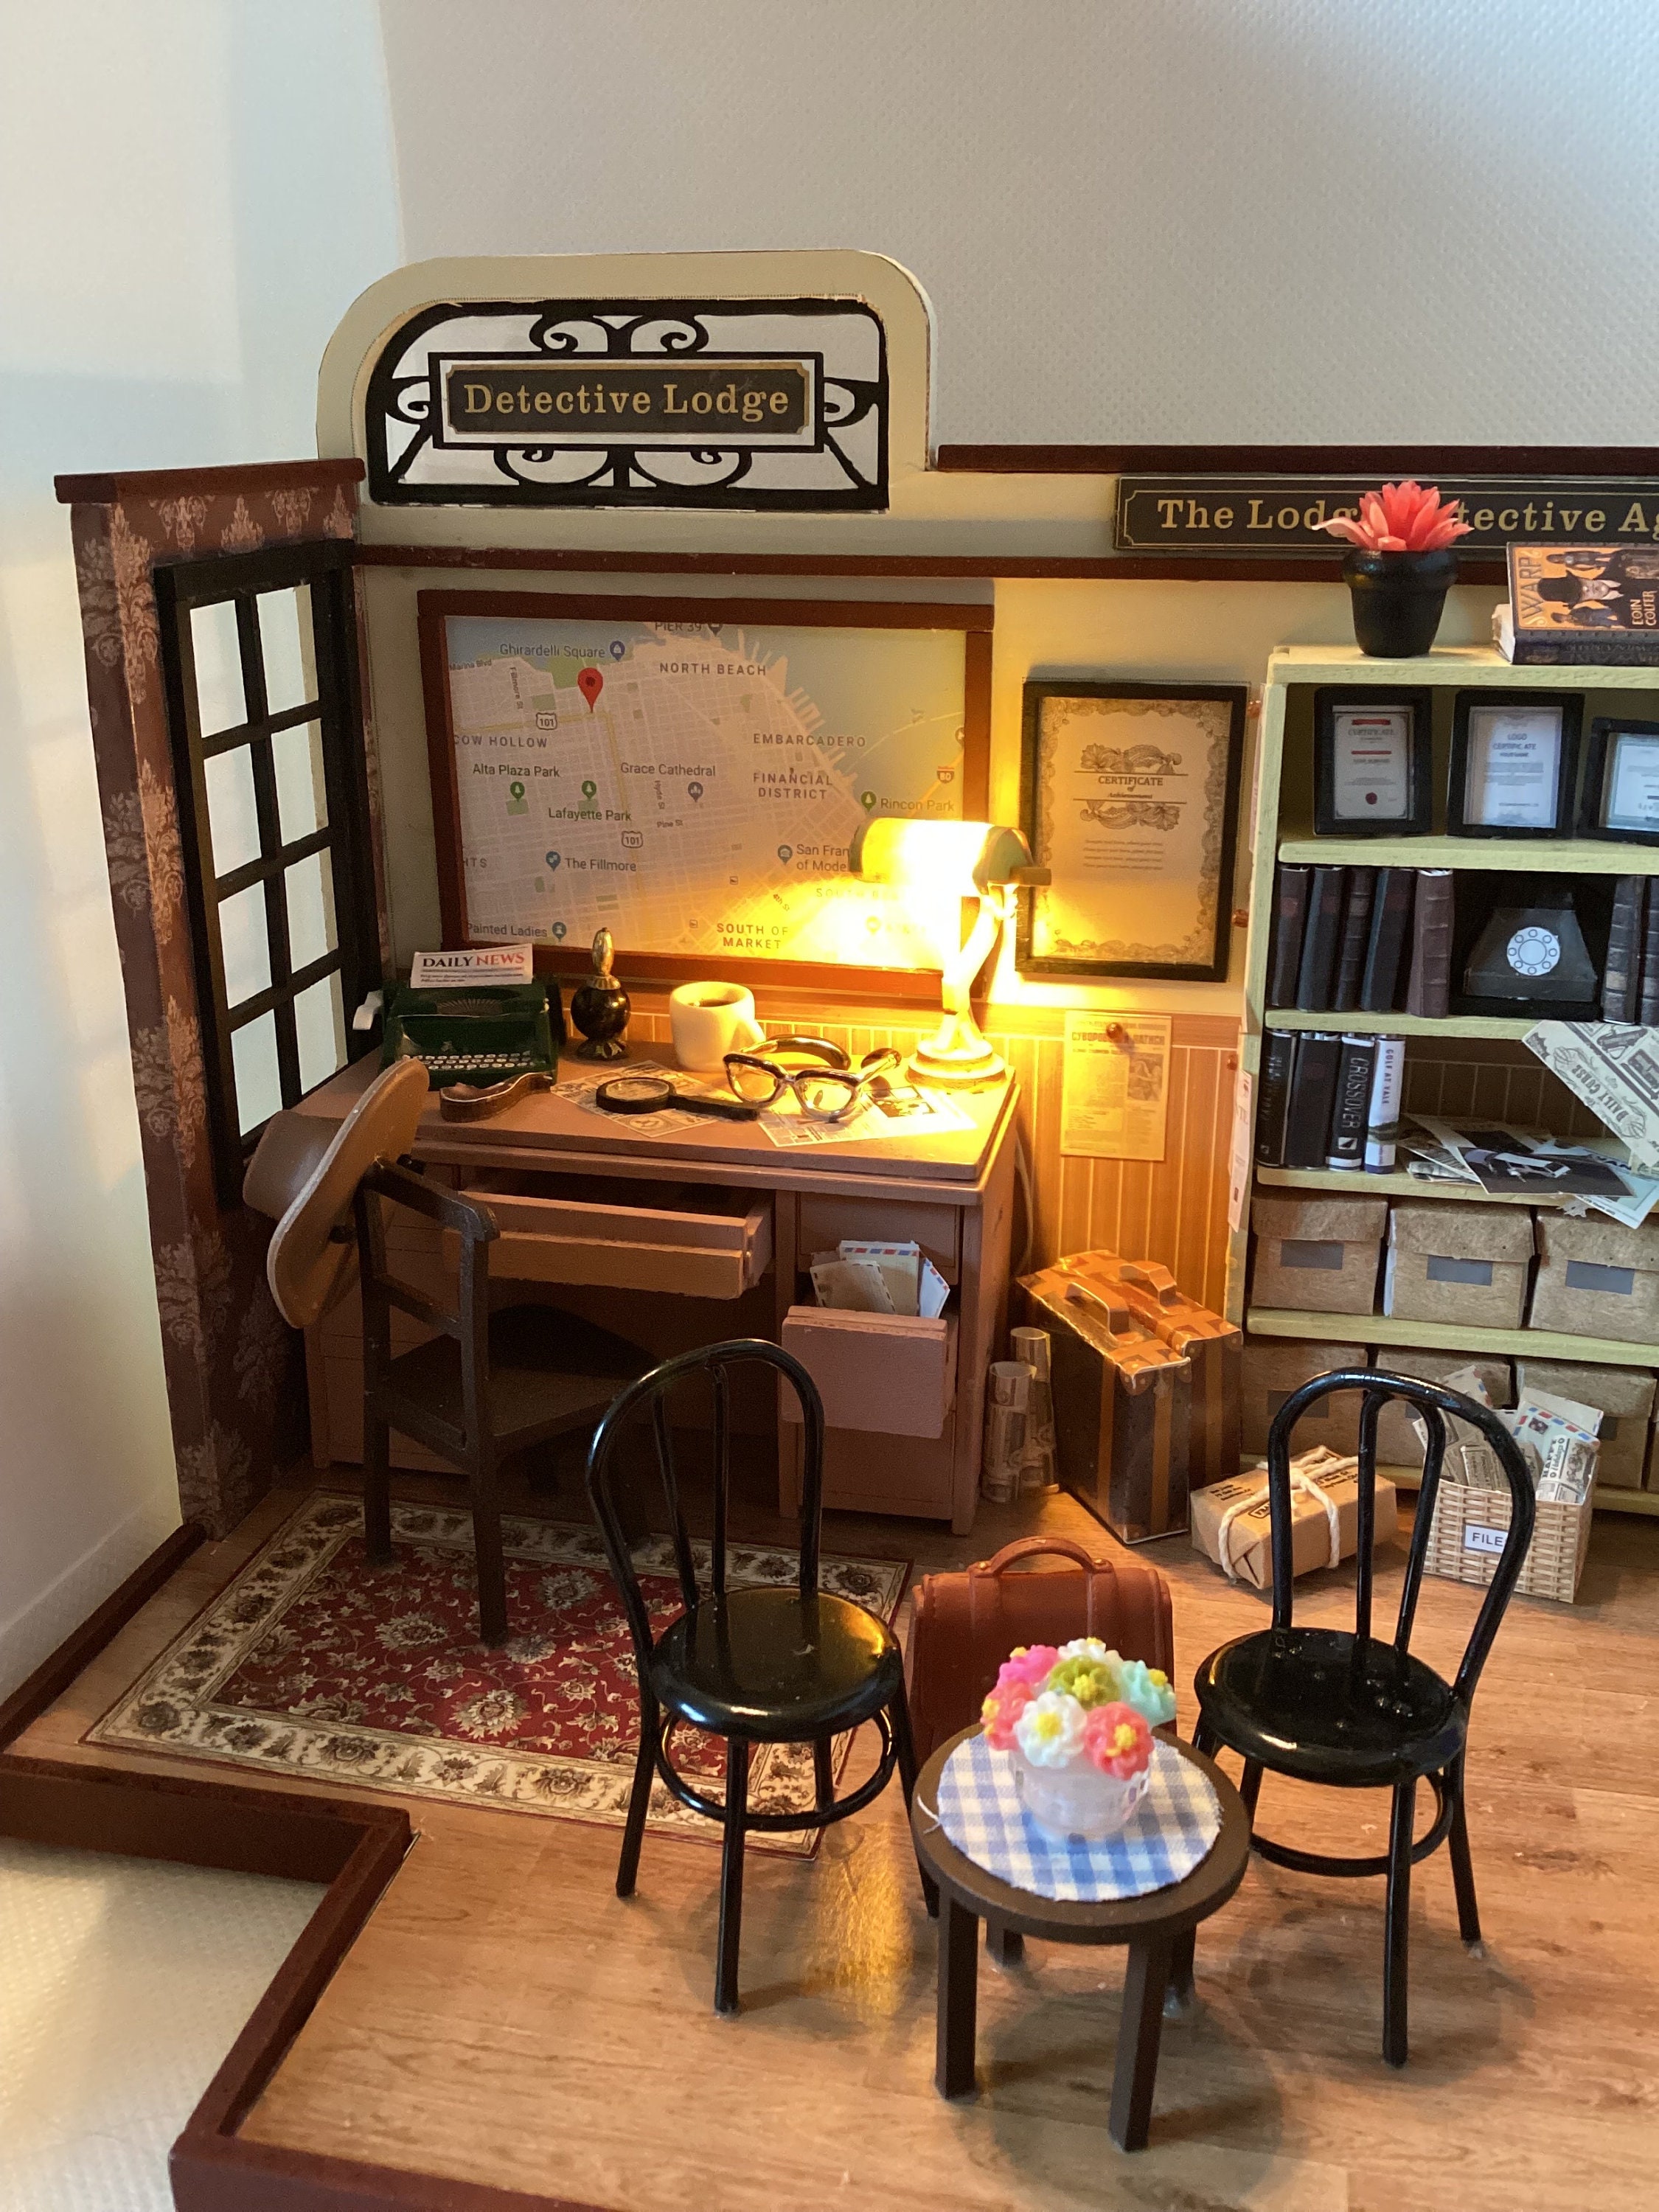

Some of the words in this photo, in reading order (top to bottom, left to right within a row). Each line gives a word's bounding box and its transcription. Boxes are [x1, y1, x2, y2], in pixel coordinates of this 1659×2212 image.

[464, 383, 652, 414] Detective
[663, 383, 790, 422] Lodge
[1157, 498, 1234, 529] The
[1247, 498, 1358, 530] Lod
[1453, 500, 1607, 533] tective
[1518, 556, 1546, 619] WARP
[1629, 599, 1644, 626] EOIN
[655, 622, 683, 632] PIER
[686, 623, 702, 633] 39
[499, 643, 560, 657] Ghirardelli
[563, 645, 606, 660] Square
[659, 663, 710, 674] NORTH
[717, 664, 766, 676] BEACH
[539, 718, 555, 728] 101
[489, 736, 548, 748] HOLLOW
[753, 733, 866, 748] EMBARCADERO
[473, 763, 495, 775] Alta
[498, 765, 531, 776] Plaza
[534, 765, 560, 778] Park
[620, 762, 655, 774] Grace
[658, 763, 716, 776] Cathedral
[753, 772, 833, 787] FINANCIAL
[1098, 776, 1164, 787] CERTIFICATE
[758, 787, 827, 800] DISTRICT
[880, 798, 922, 810] Rincon
[926, 799, 954, 812] Park
[548, 807, 602, 822] Lafayette
[605, 810, 632, 821] Park
[625, 836, 640, 845] 101
[796, 844, 819, 856] San
[564, 858, 587, 870] The
[590, 858, 636, 872] Fillmore
[796, 860, 810, 872] of
[510, 925, 548, 937] Ladies
[716, 922, 765, 935] SOUTH
[771, 925, 789, 936] OF
[723, 936, 782, 950] MARKET
[422, 956, 473, 967] DAILY
[476, 952, 525, 966] NEWS
[1571, 1064, 1601, 1095] CURSE
[1342, 1057, 1369, 1129] CROSSOVER
[1598, 1093, 1630, 1123] DAILY
[1472, 1532, 1504, 1547] FILE
